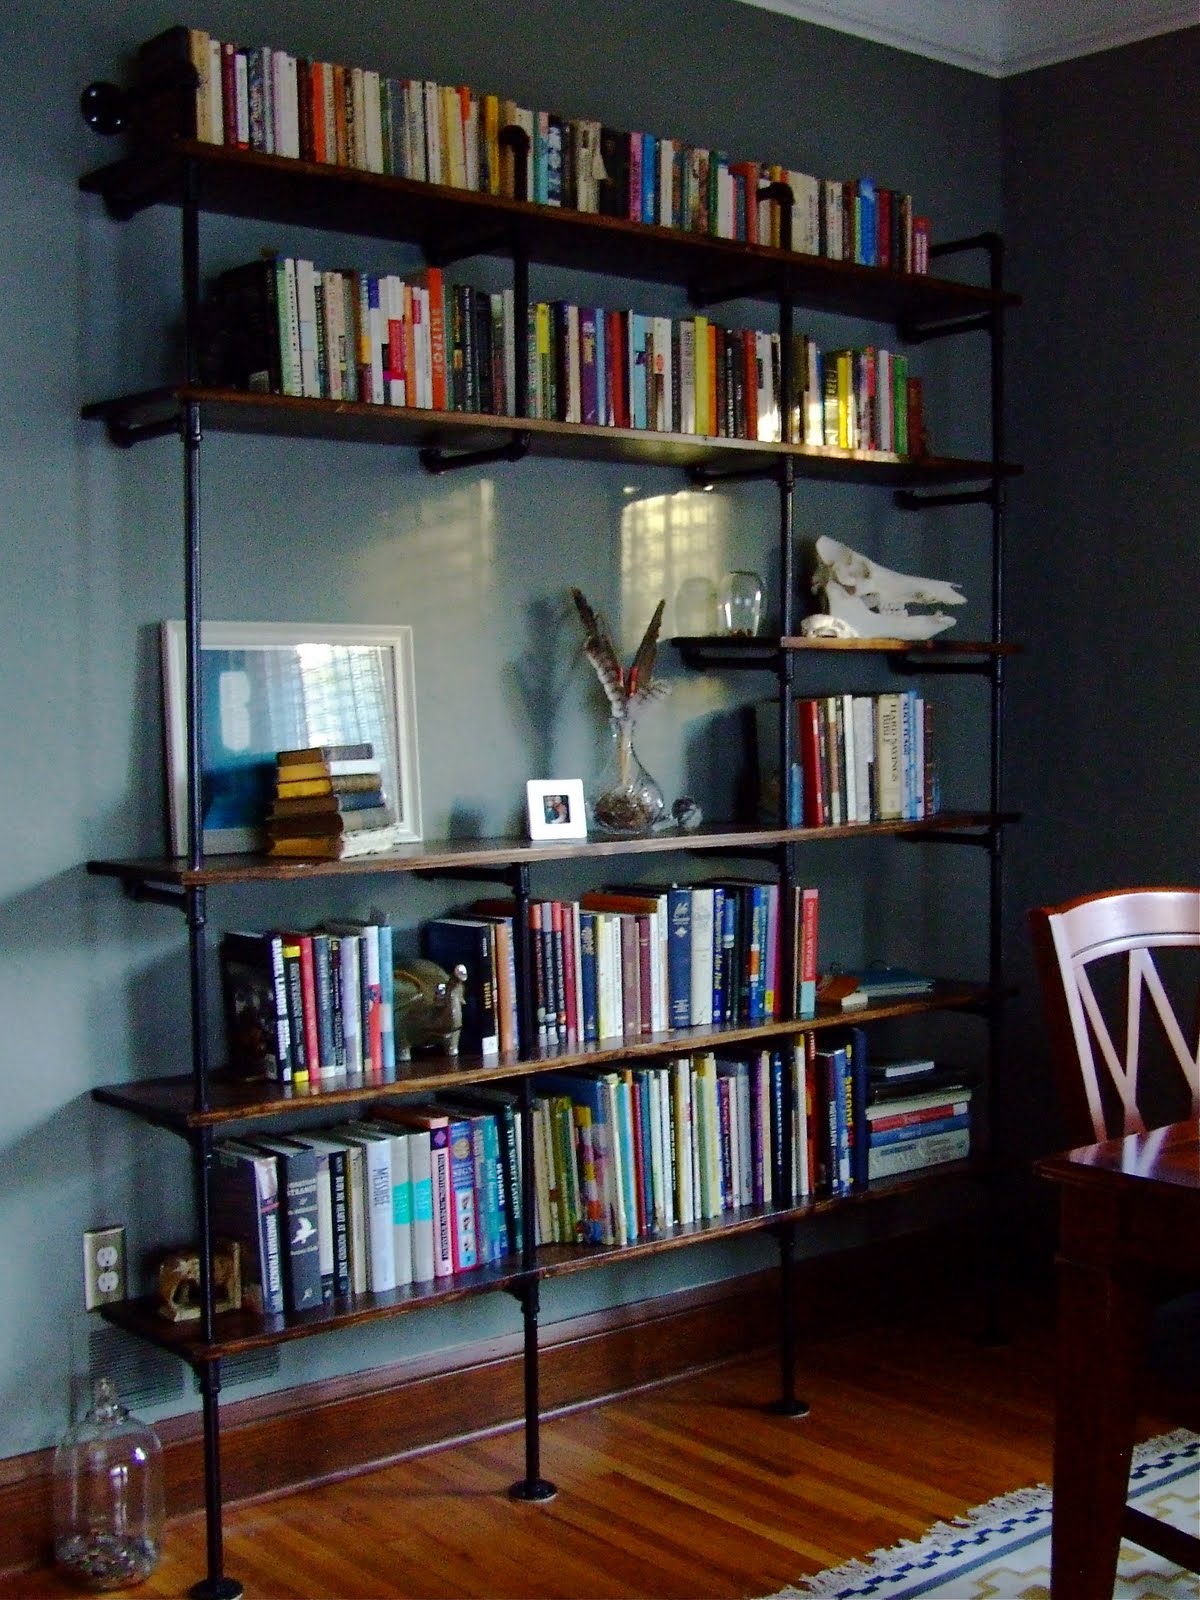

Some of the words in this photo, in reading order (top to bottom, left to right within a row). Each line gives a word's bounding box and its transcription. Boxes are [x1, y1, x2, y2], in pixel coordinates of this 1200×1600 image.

[271, 938, 284, 977] DANIEL
[274, 977, 287, 1015] LANOIS
[508, 1148, 517, 1180] SECRET
[373, 1167, 390, 1207] MESSAGE
[496, 1163, 505, 1205] DEVIANCE
[511, 1182, 519, 1218] GARDEN
[266, 1214, 277, 1253] JONATHAN
[268, 1254, 279, 1291] FRANZEN
